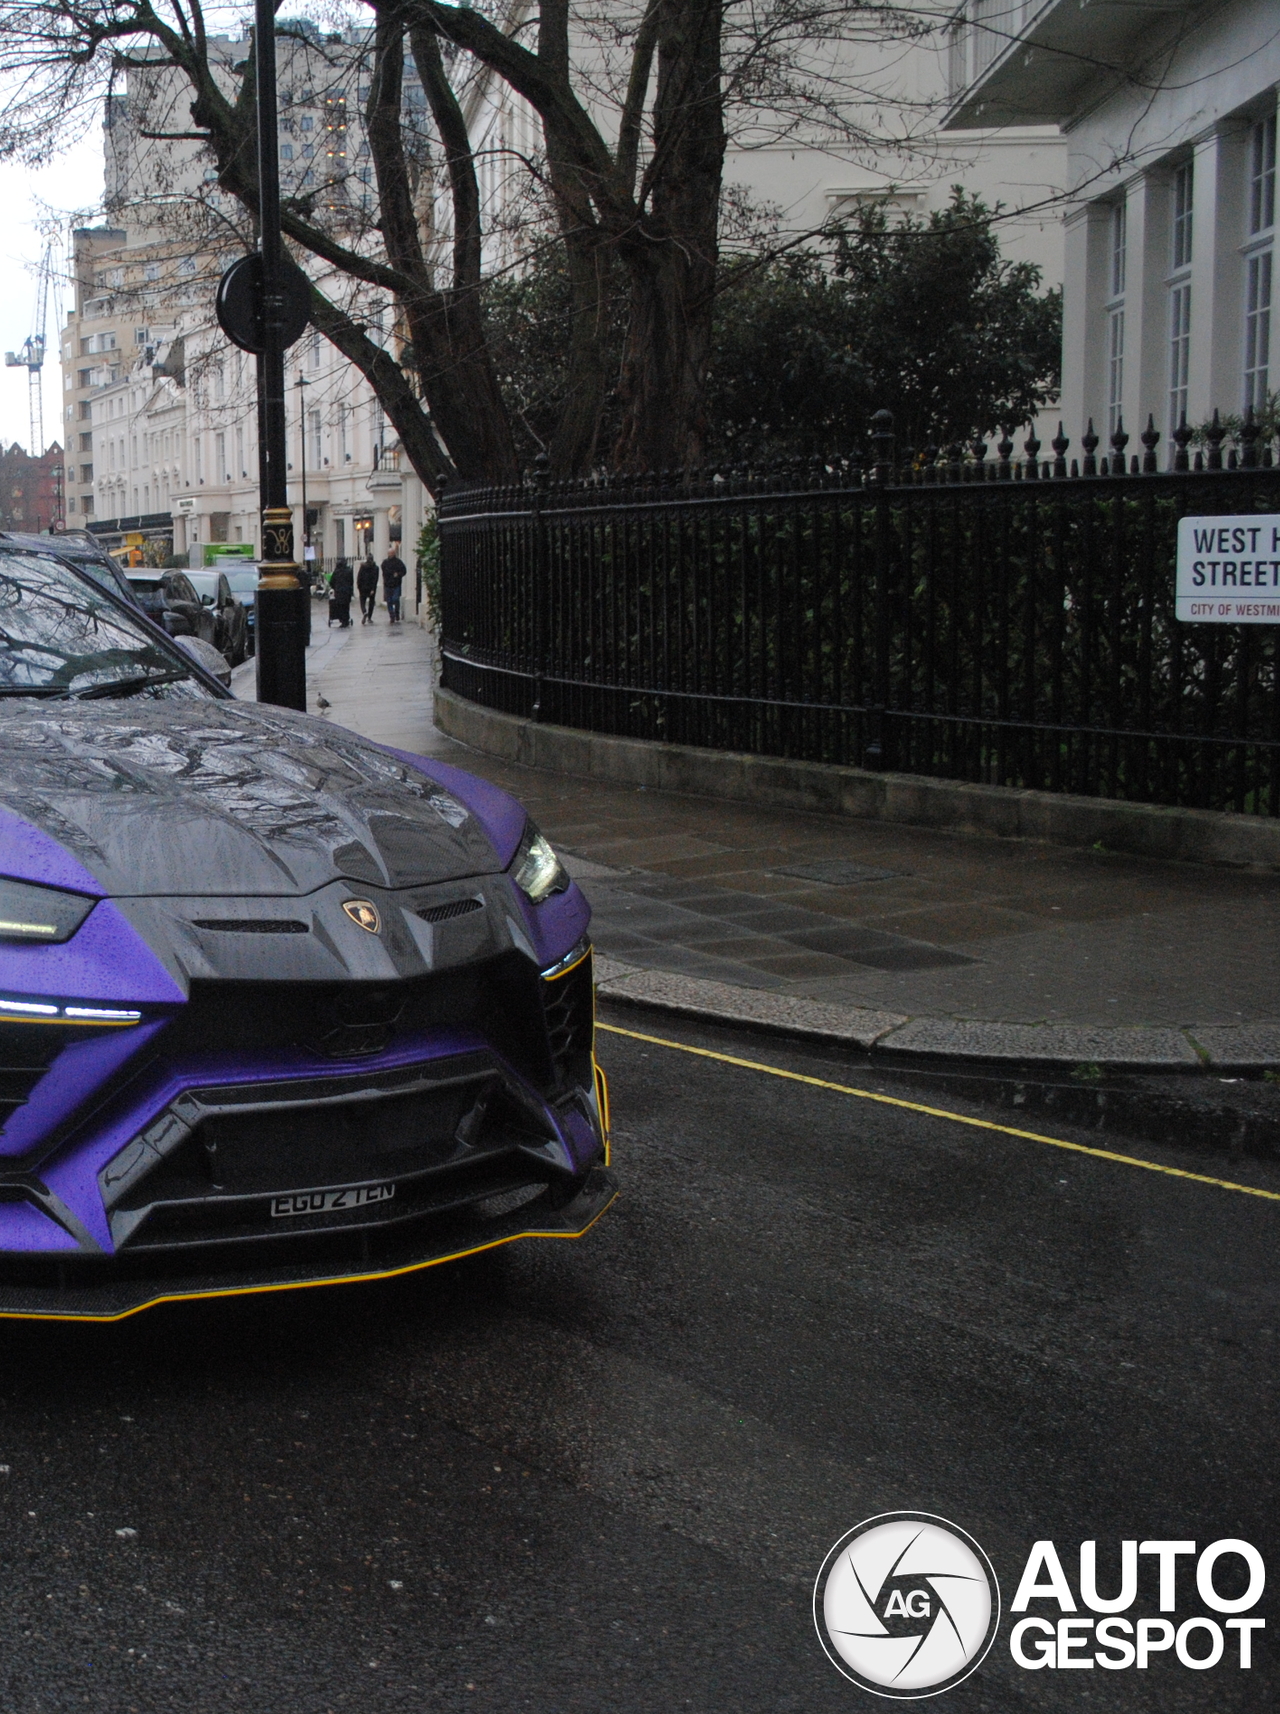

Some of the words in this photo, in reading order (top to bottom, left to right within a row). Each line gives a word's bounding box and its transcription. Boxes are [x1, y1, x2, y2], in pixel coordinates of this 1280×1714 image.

[1193, 527, 1261, 554] WEST
[1192, 561, 1280, 586] STREET
[1190, 603, 1214, 615] CITY
[1218, 604, 1232, 616] OF
